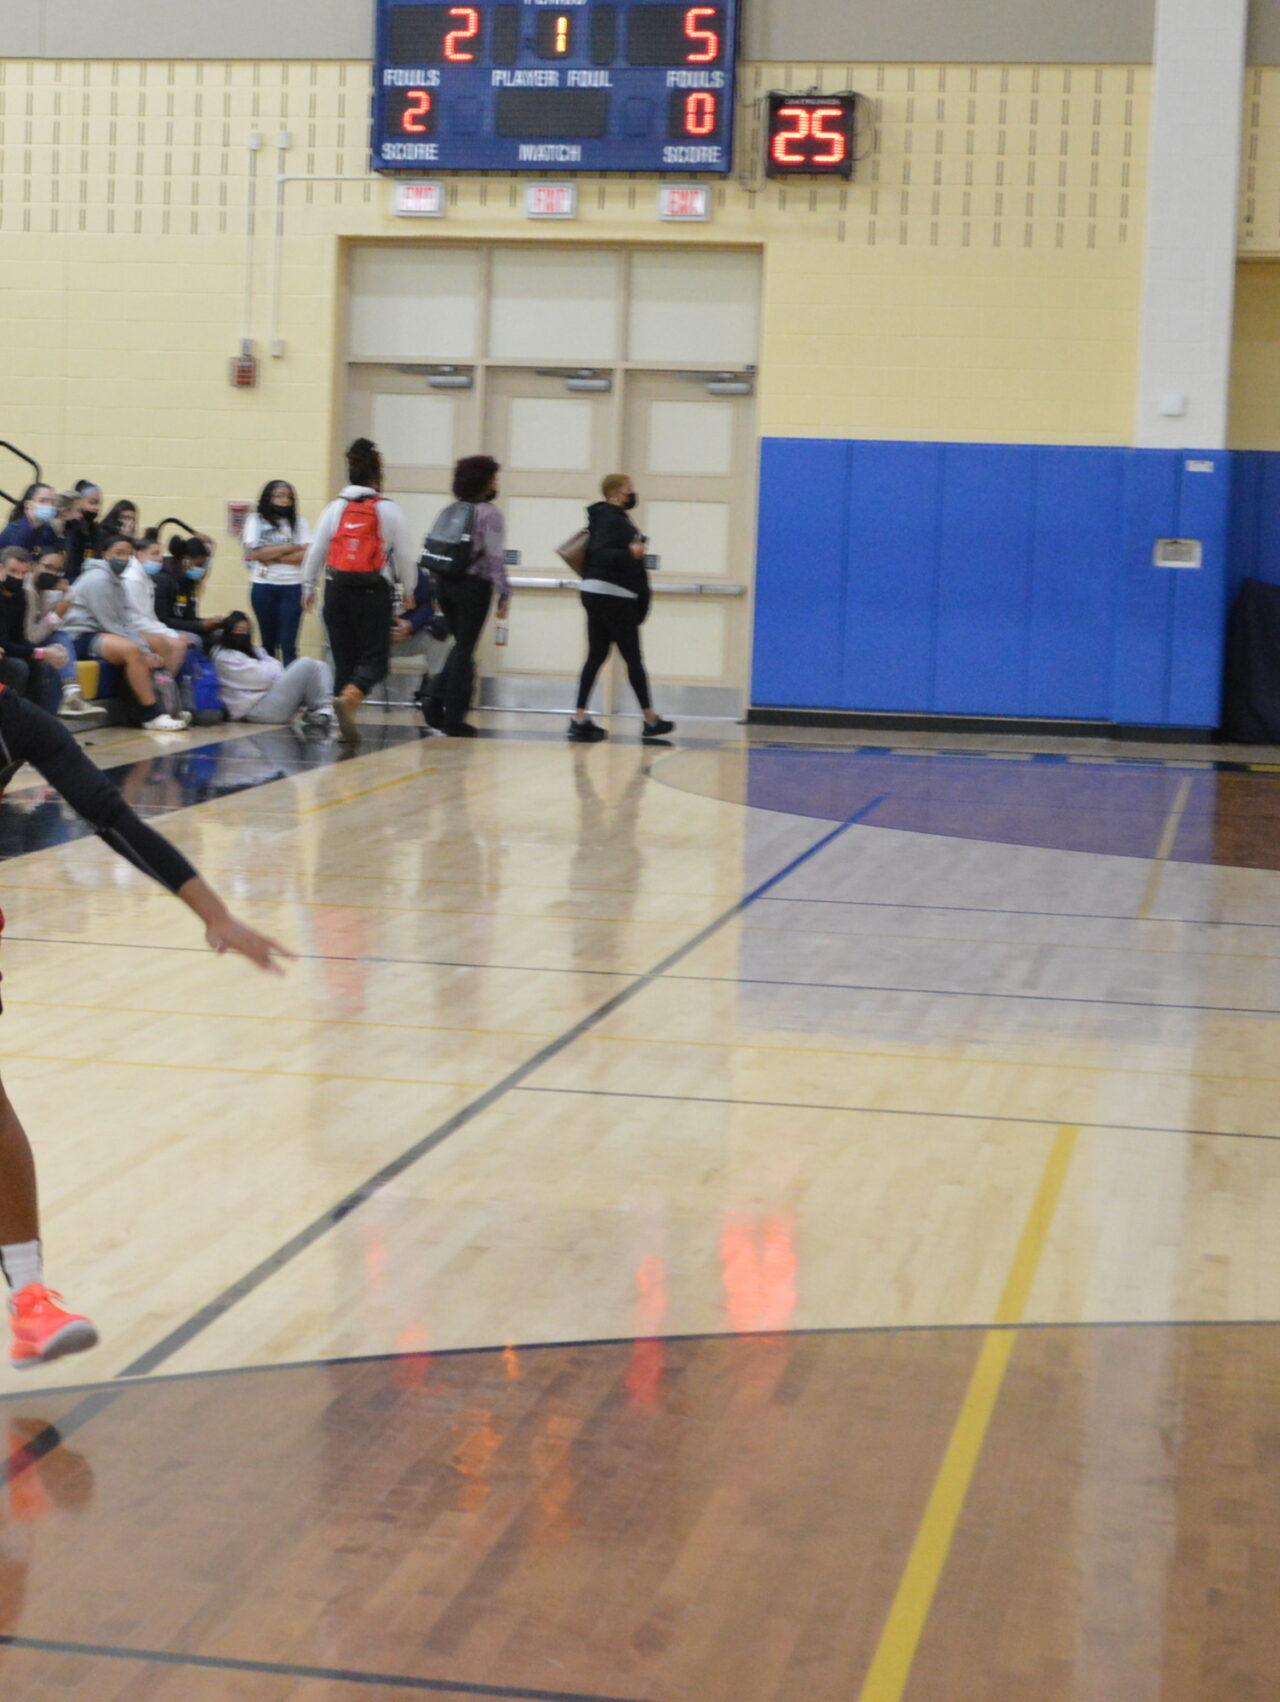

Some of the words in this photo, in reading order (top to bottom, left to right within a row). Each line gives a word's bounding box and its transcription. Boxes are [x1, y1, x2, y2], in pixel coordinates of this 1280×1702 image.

[444, 8, 478, 61] 2
[556, 16, 568, 52] 1
[685, 7, 718, 62] 5
[383, 69, 440, 86] FOULS
[491, 69, 559, 87] PLAYER
[567, 70, 613, 87] FOUL
[666, 70, 724, 87] FOULS
[402, 90, 431, 132] 2
[685, 92, 715, 134] 0
[773, 108, 844, 163] 25
[381, 143, 439, 160] SCORE
[519, 144, 581, 161] MATCH
[662, 146, 721, 163] SCORE
